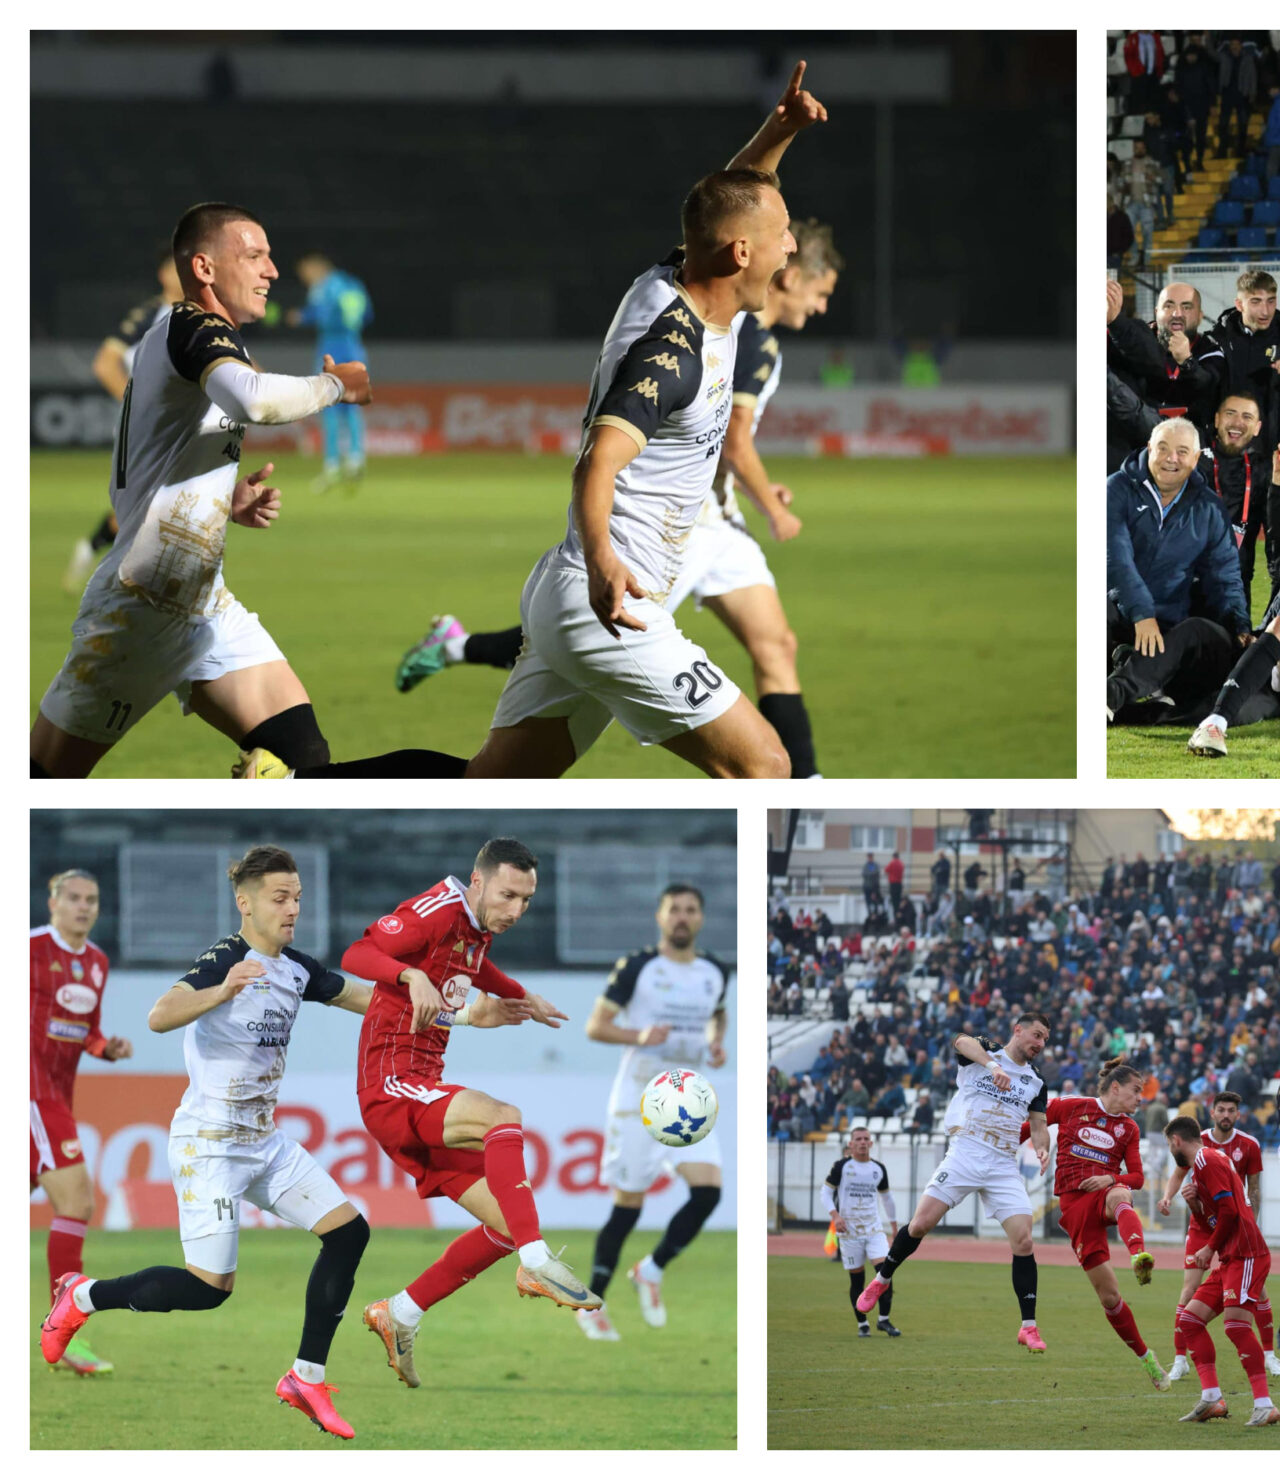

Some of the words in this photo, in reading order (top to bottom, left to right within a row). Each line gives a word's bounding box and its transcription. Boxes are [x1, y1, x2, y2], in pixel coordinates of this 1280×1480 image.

[673, 660, 723, 710] 20
[106, 700, 133, 732] 11
[213, 1197, 234, 1221] 14
